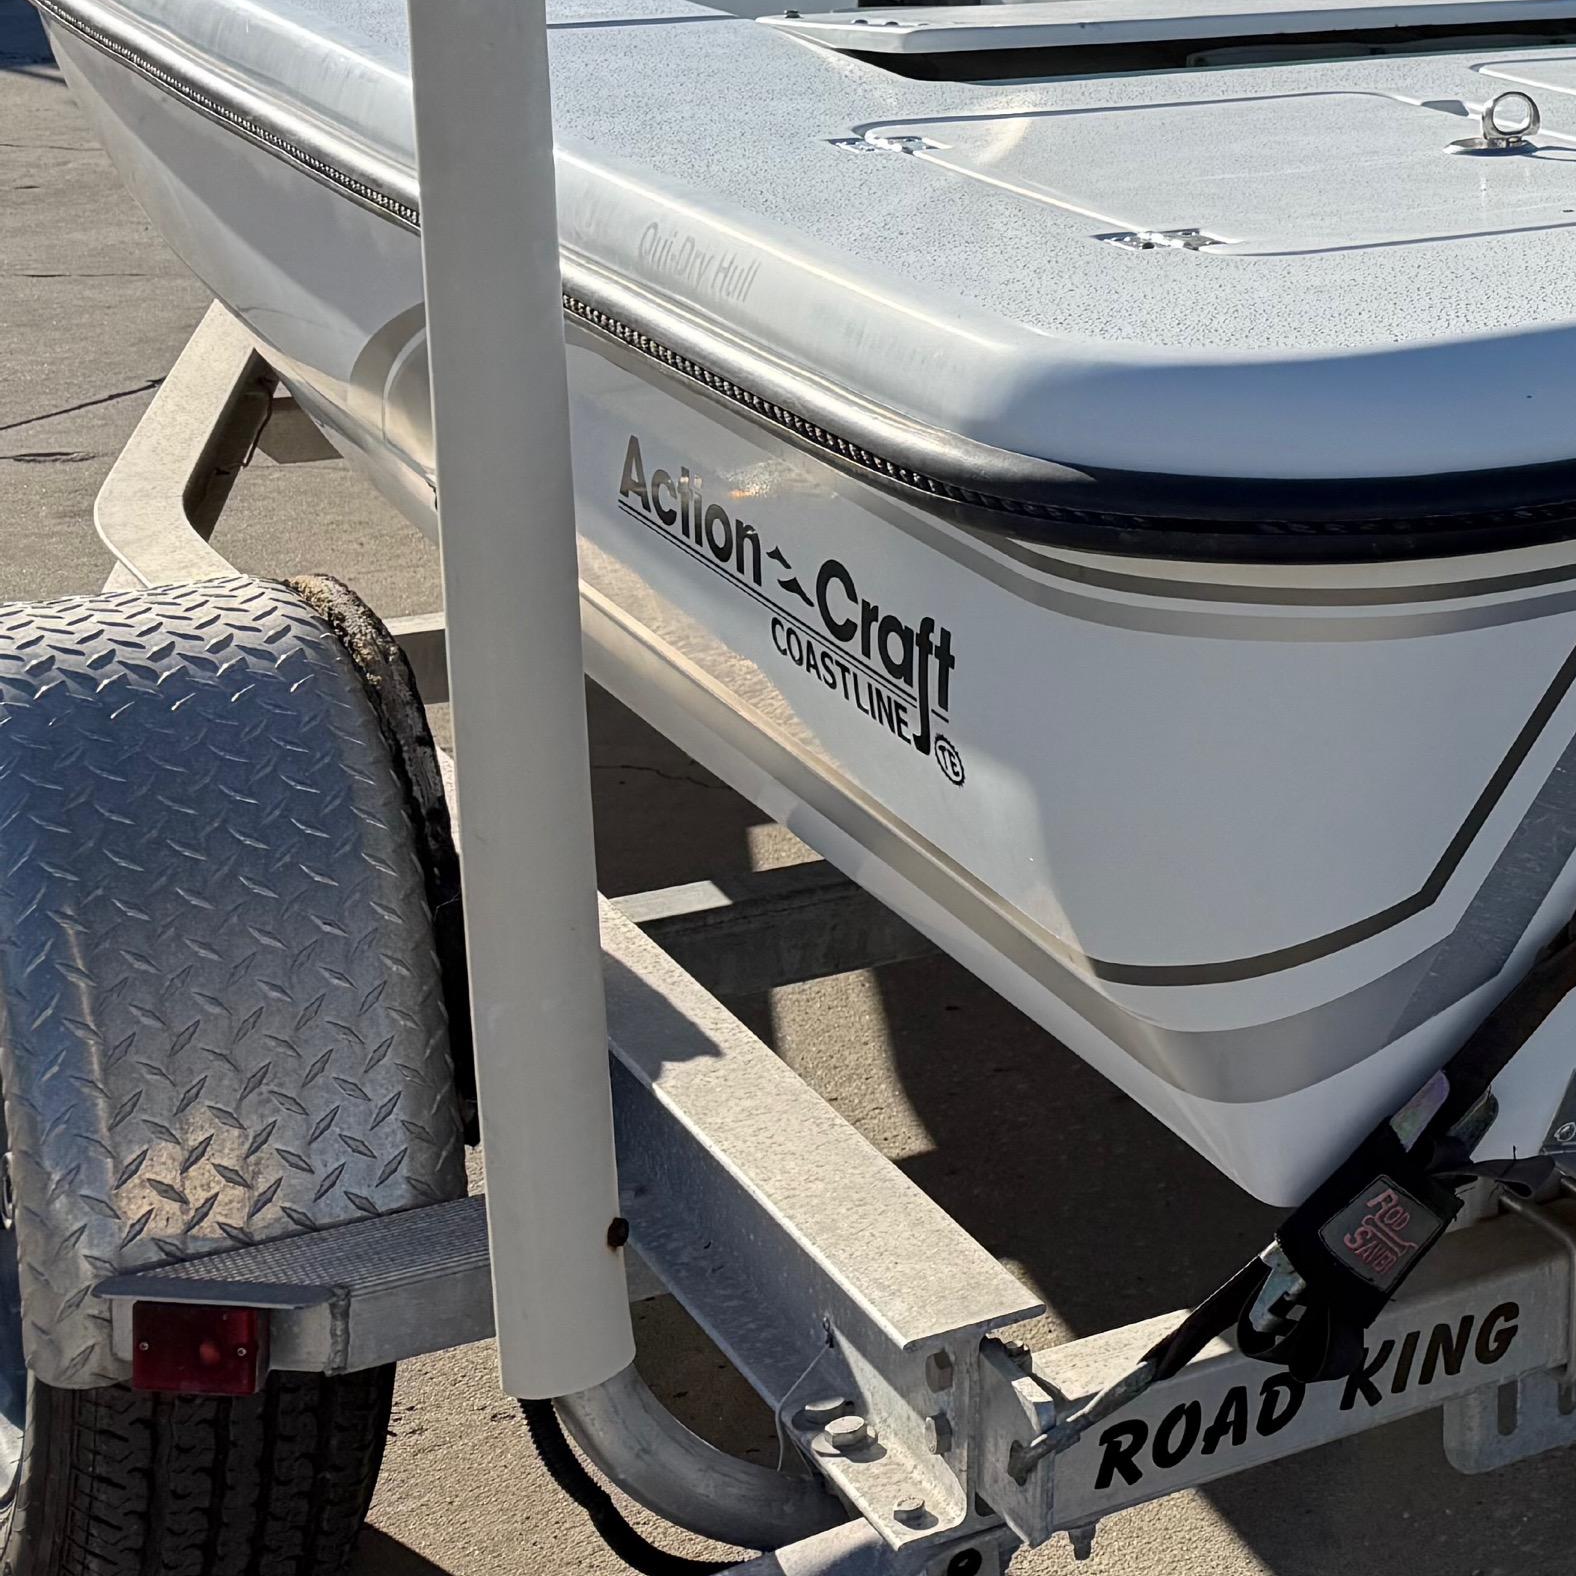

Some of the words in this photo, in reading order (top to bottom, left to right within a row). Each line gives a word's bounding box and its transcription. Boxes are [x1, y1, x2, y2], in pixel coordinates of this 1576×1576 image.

[618, 435, 763, 587] Action
[816, 559, 956, 756] Craft
[771, 616, 913, 744] COASTLINE
[1094, 1372, 1306, 1490] ROAD
[1339, 1301, 1520, 1412] KING
